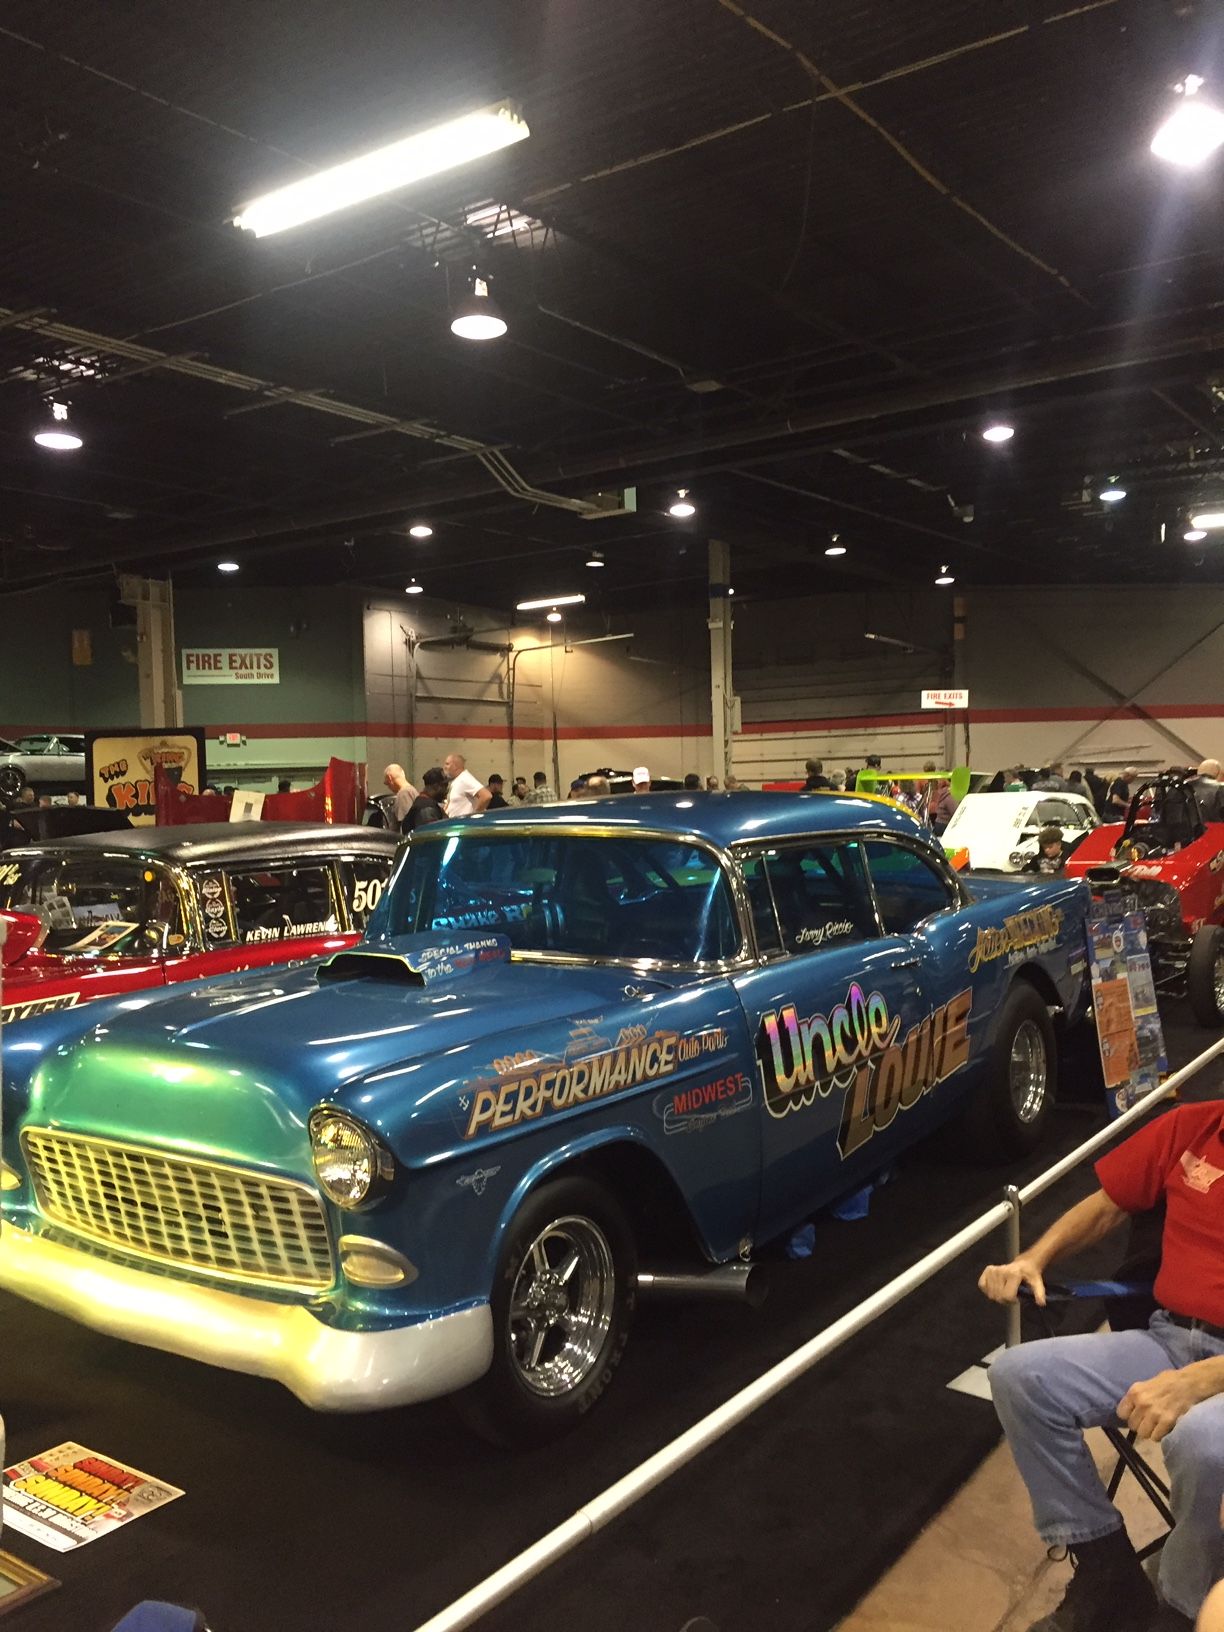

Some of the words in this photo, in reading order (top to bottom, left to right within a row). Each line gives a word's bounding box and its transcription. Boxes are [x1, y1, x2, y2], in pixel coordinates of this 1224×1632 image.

[186, 653, 222, 670] FIRE
[228, 653, 274, 670] EXITS
[235, 672, 254, 680] South
[245, 927, 281, 942] KEVIN
[418, 945, 463, 962] SPECIAL
[464, 938, 498, 951] THANKS
[757, 981, 900, 1115] Uncle
[463, 1035, 678, 1140] PERFORMANCE
[678, 1037, 700, 1061] Auto
[701, 1028, 730, 1052] Parts
[673, 1072, 743, 1115] MIDWEST
